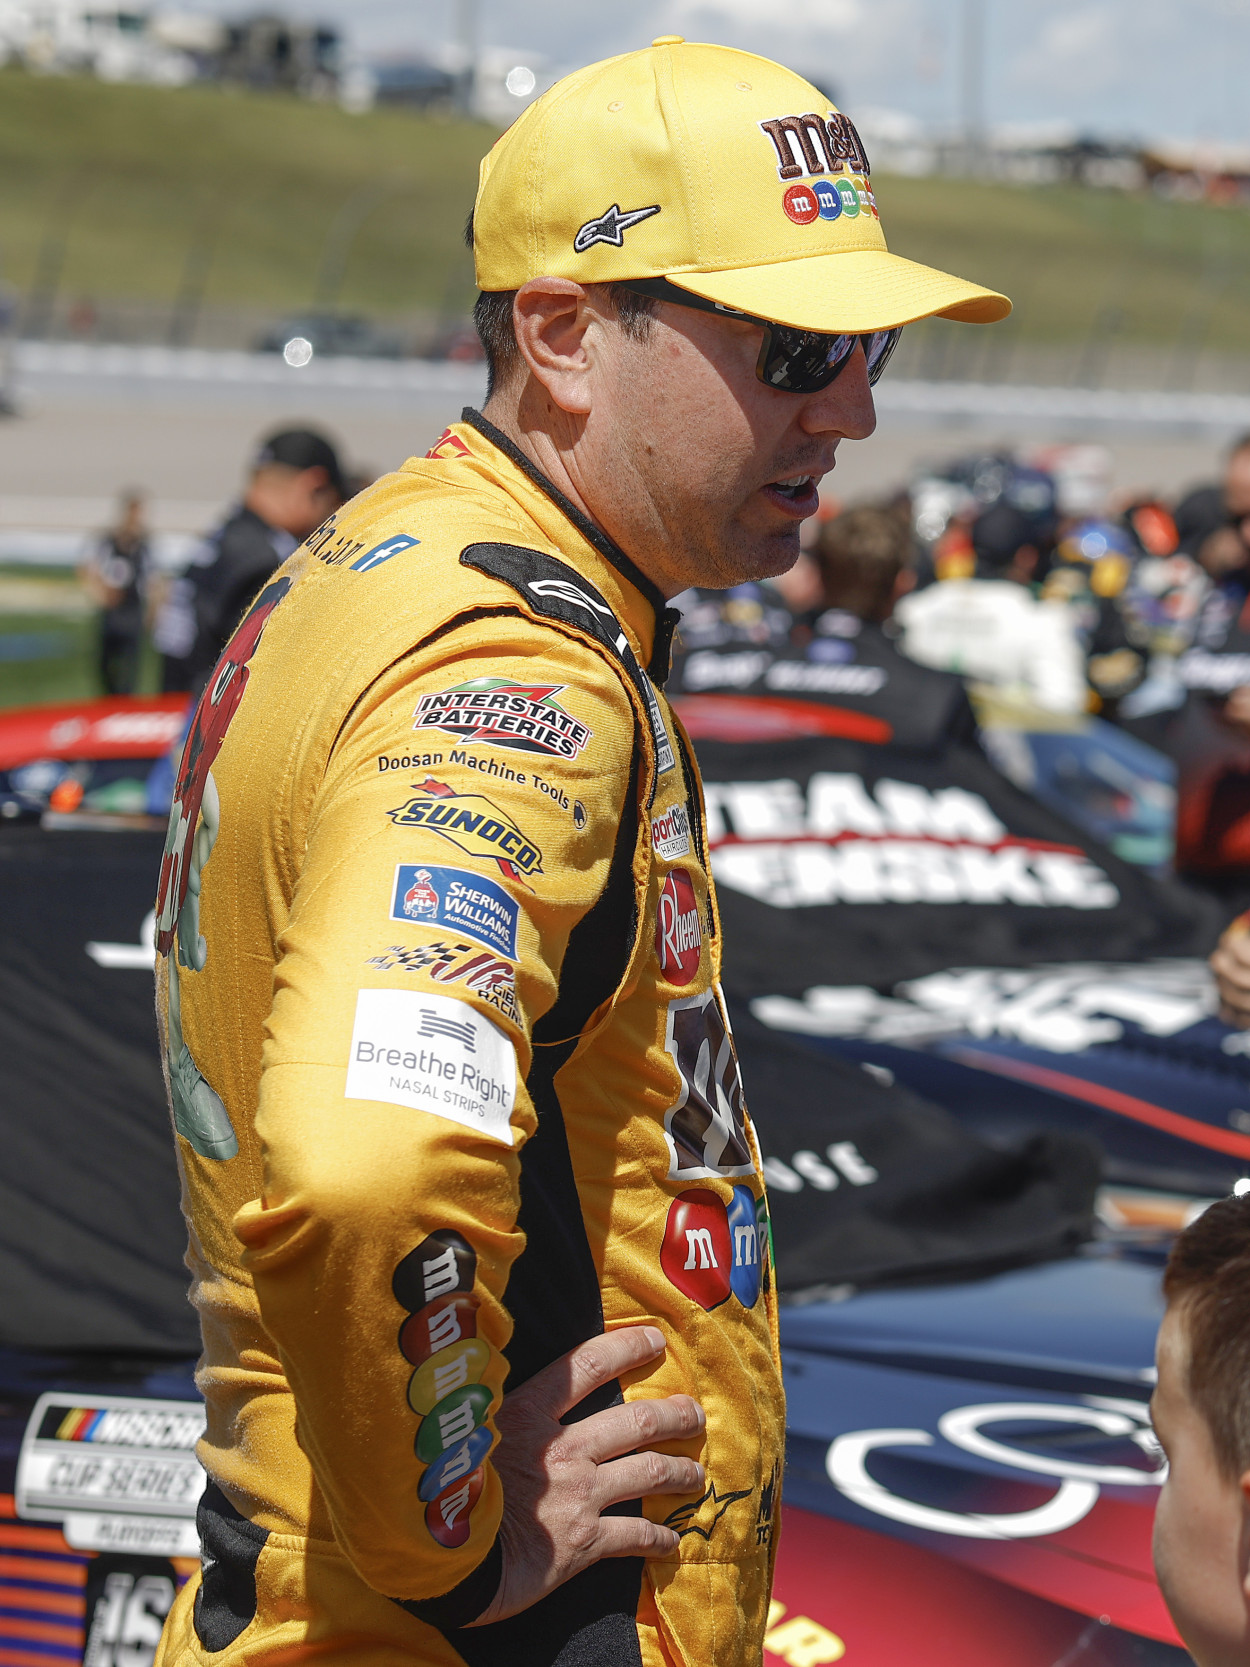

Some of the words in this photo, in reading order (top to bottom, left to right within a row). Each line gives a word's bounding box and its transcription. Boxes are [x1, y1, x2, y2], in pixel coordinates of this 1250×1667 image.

[791, 196, 812, 212] m
[818, 192, 837, 208] m
[420, 693, 587, 747] INTERSTATE
[422, 709, 576, 757] BATTERIES
[378, 752, 443, 772] Doosan
[449, 750, 526, 785] Machine
[532, 775, 569, 810] Tools
[400, 802, 538, 870] SUNOCO
[712, 839, 1120, 909] ENSKE
[443, 913, 490, 937] Automotive
[444, 896, 511, 942] WILLIAMS
[446, 882, 512, 926] SHERWIN
[660, 872, 702, 971] Rheem
[355, 1041, 457, 1081] Breathe
[460, 1062, 509, 1108] Right
[389, 1076, 439, 1100] NASAL
[443, 1090, 486, 1118] STRIPS
[683, 1227, 719, 1270] m
[734, 1223, 758, 1267] m
[422, 1246, 460, 1302] m
[427, 1302, 462, 1354] m
[433, 1353, 468, 1401] m
[438, 1399, 476, 1450] m
